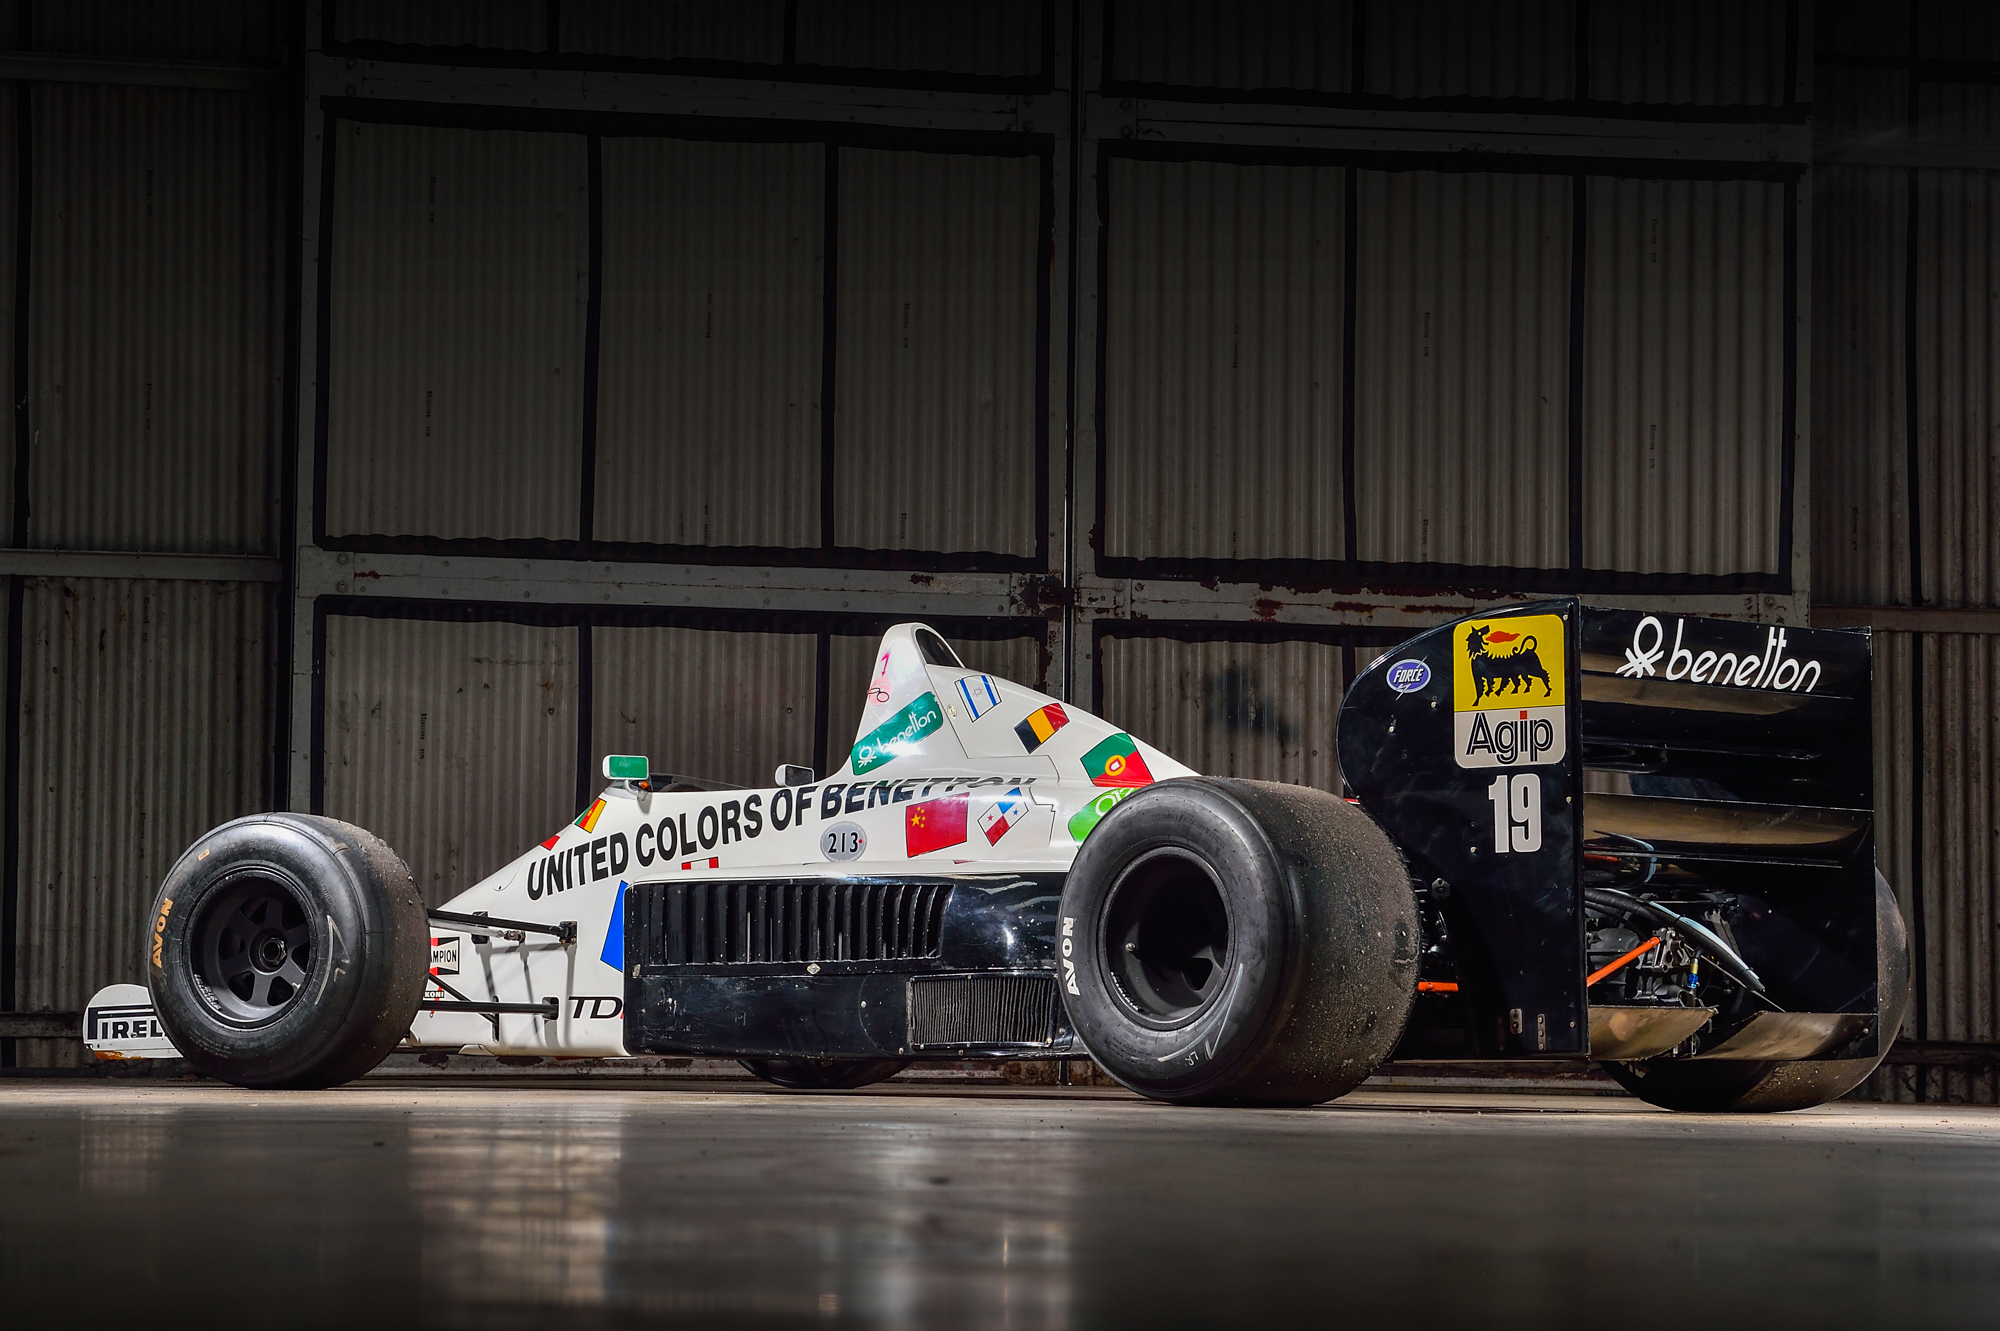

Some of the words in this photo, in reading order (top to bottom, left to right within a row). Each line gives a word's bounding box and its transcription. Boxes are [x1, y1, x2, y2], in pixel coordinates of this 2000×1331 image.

[1393, 668, 1424, 683] FORCE
[1665, 618, 1822, 693] benetton
[876, 710, 937, 754] benetton
[1466, 710, 1554, 764] Agip
[527, 832, 629, 901] UNITED
[635, 794, 763, 867] COLORS
[770, 784, 819, 831] OF
[821, 777, 1037, 820] BENETTON
[1488, 773, 1542, 853] 19
[828, 832, 858, 853] 213
[153, 897, 173, 968] AVON
[431, 950, 457, 963] MPION
[1062, 917, 1080, 996] AVON
[568, 996, 624, 1019] TD
